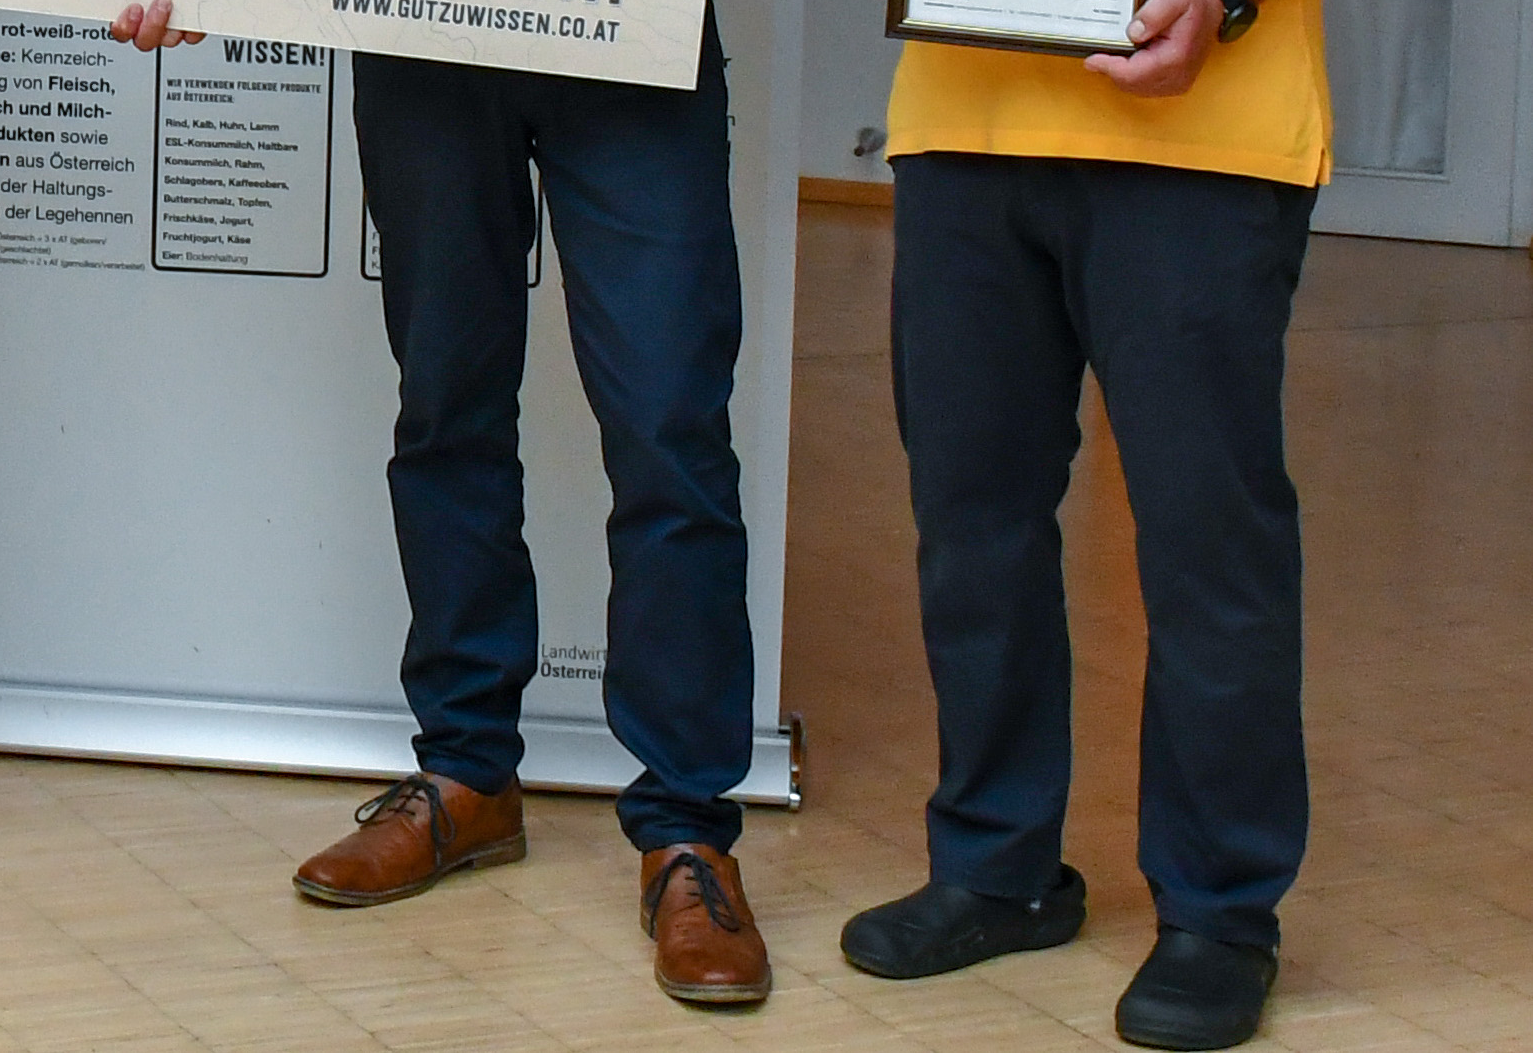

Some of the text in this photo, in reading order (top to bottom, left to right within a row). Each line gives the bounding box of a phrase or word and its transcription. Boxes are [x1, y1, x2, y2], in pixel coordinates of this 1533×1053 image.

[21, 48, 114, 66] Kennzeich-
[223, 39, 325, 66] WISSEN!
[13, 78, 43, 90] von
[48, 75, 116, 96] Fleisch,
[167, 78, 321, 94] WIR VERWENDEN FOLGENDE PRODUKTE
[166, 92, 181, 101] AUS
[18, 101, 51, 116] und
[57, 102, 112, 119] Milch-
[165, 118, 280, 131] Rind, Kalb, Huhn, Lamm
[60, 129, 109, 145] sowie
[165, 137, 299, 152] ESL-Konsummilch, Haltbare
[15, 155, 44, 169] aus
[49, 151, 135, 172] Österreich
[164, 156, 265, 170] Konsummilch, Rahm,
[0, 178, 28, 193] der
[33, 179, 113, 201] Haltungs-
[164, 175, 289, 190] Schlagobers, Kaffeeobers,
[163, 194, 273, 209] Butterschmalz, Topfen,
[5, 204, 31, 219] der
[35, 205, 134, 225] Legehennen
[163, 213, 254, 227] Frischkäse, Jogurt,
[163, 231, 252, 245] Fruchtjogurt, Käse
[162, 251, 249, 265] Eier: Bodenhaltung
